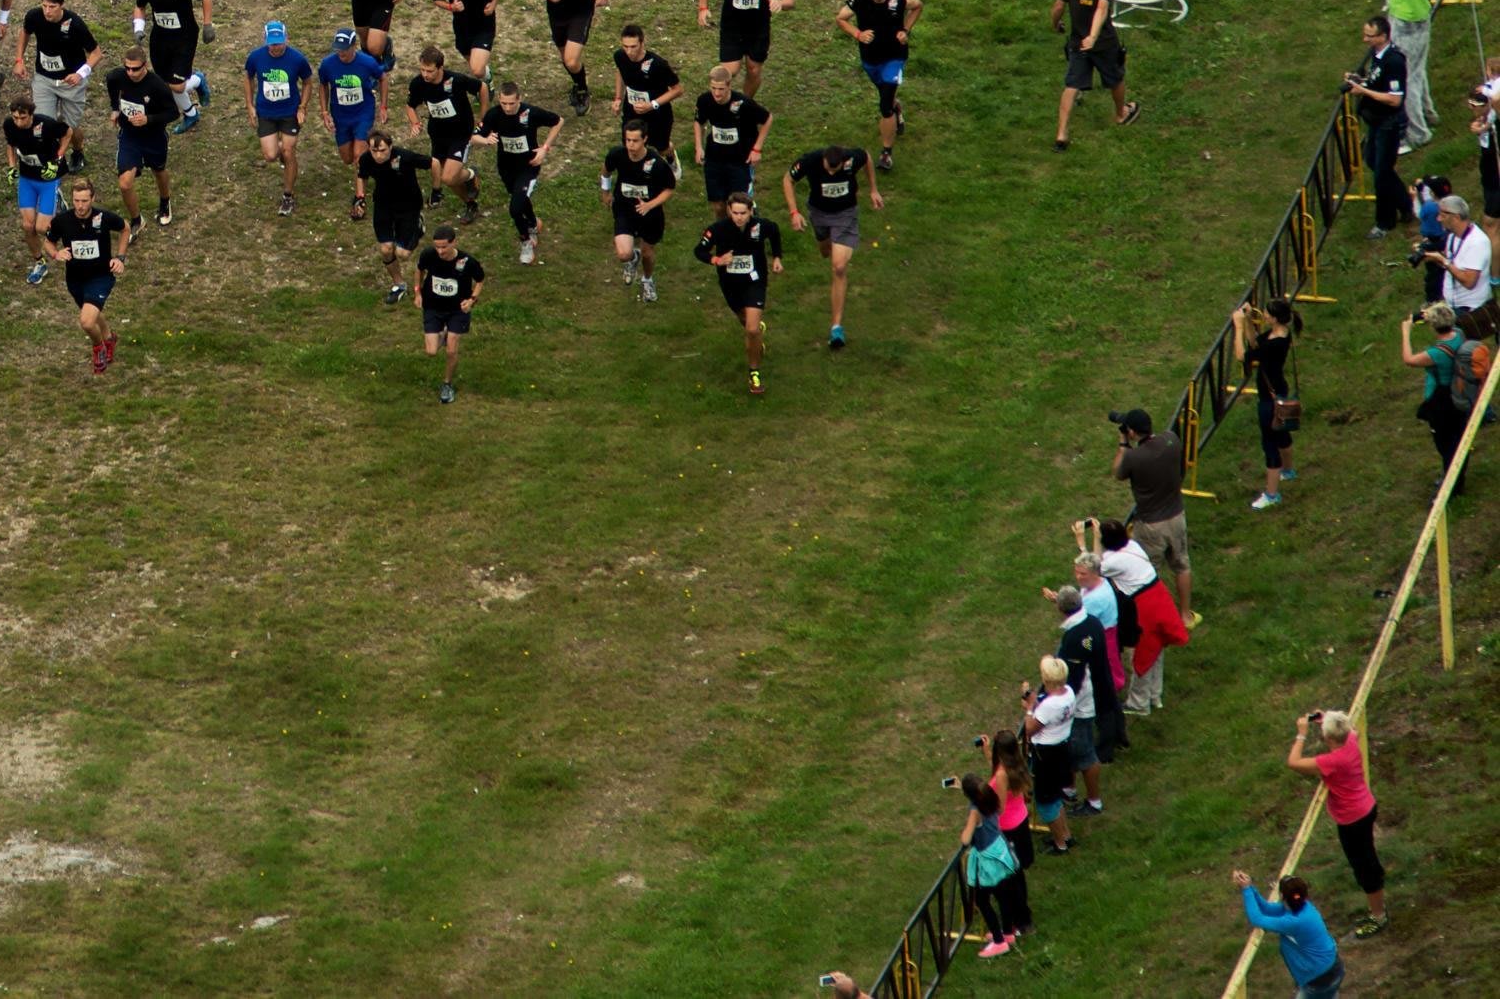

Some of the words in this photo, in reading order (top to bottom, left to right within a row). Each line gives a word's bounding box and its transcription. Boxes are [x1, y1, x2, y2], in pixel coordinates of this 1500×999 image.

[161, 18, 175, 26] 177
[47, 61, 60, 69] 178
[271, 89, 285, 97] 171
[345, 94, 360, 102] 175
[435, 107, 449, 115] 211
[509, 141, 524, 150] 212
[79, 247, 95, 255] 217
